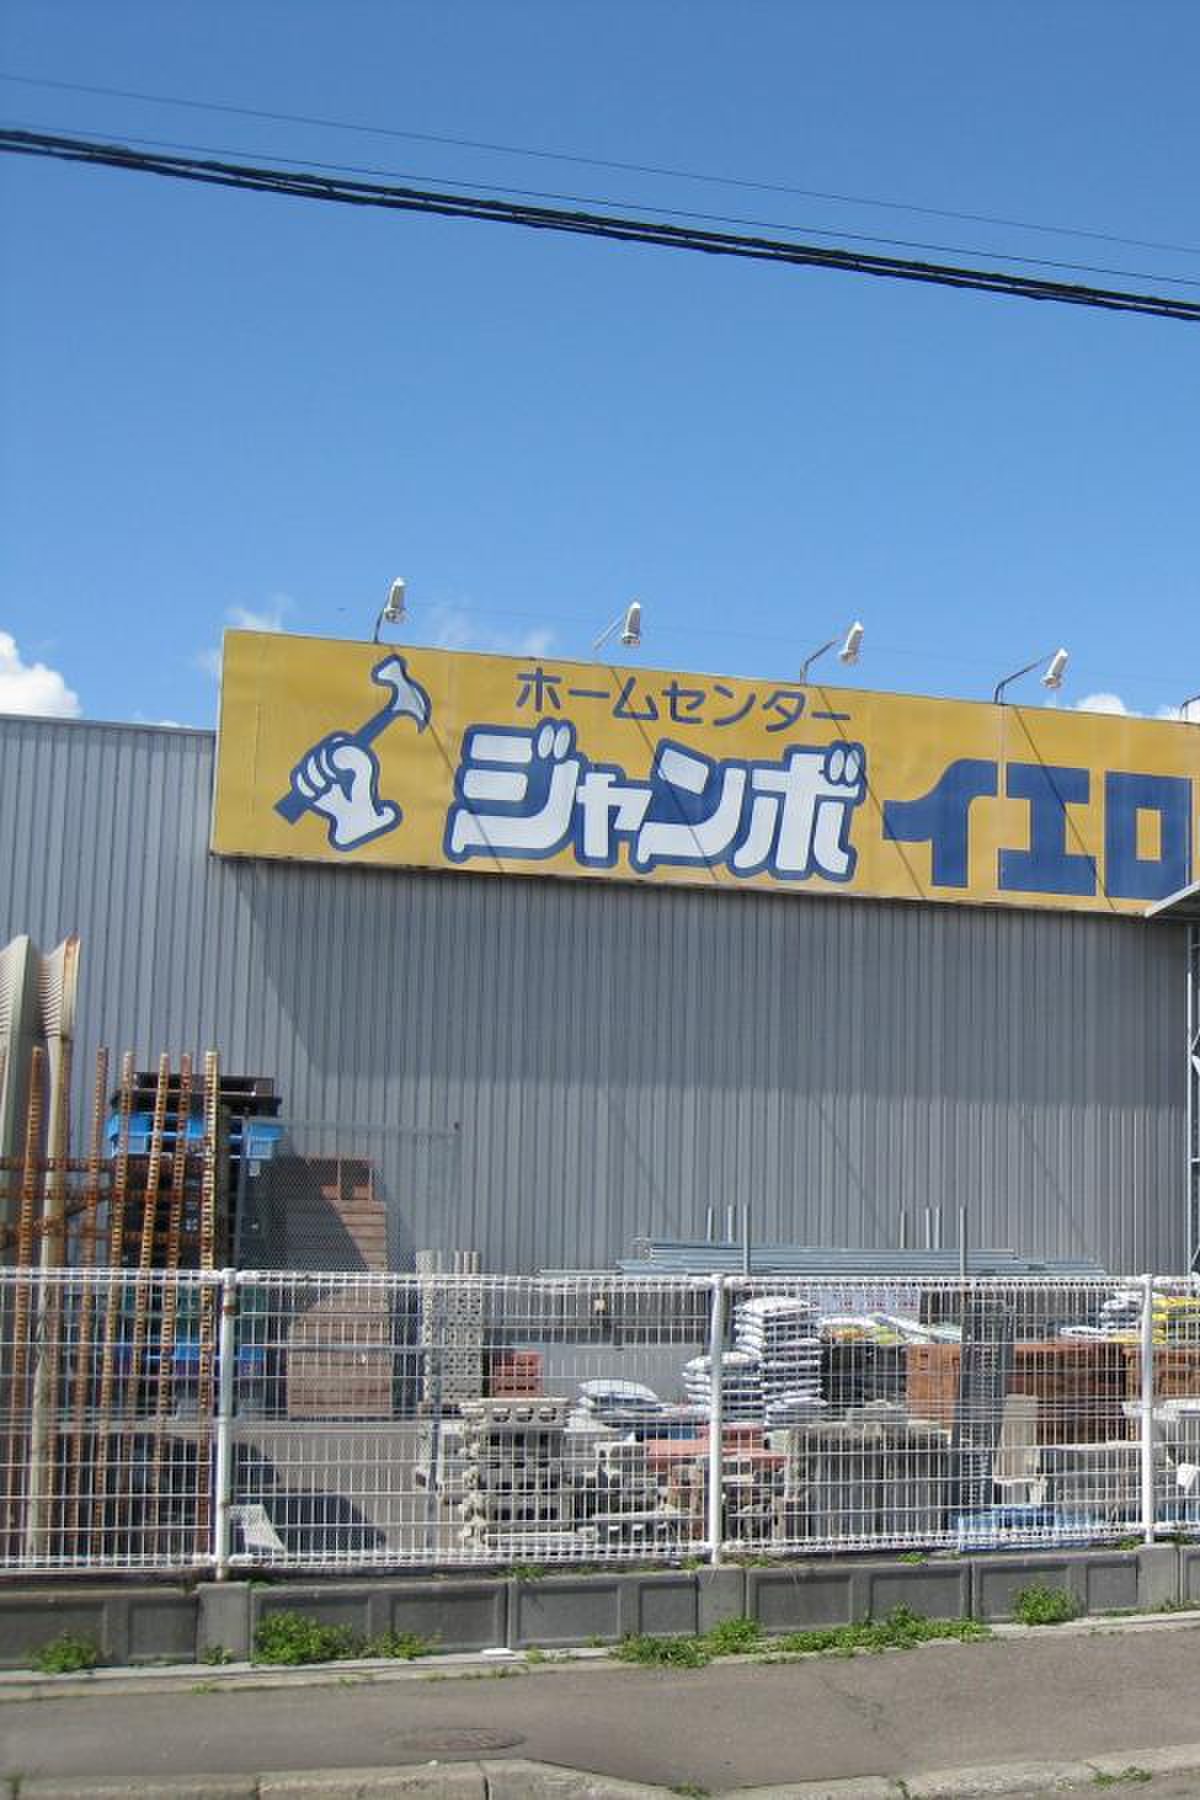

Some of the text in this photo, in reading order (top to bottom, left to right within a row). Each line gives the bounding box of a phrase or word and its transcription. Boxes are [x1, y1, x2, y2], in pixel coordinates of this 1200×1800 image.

[517, 667, 850, 732] ホームセンター
